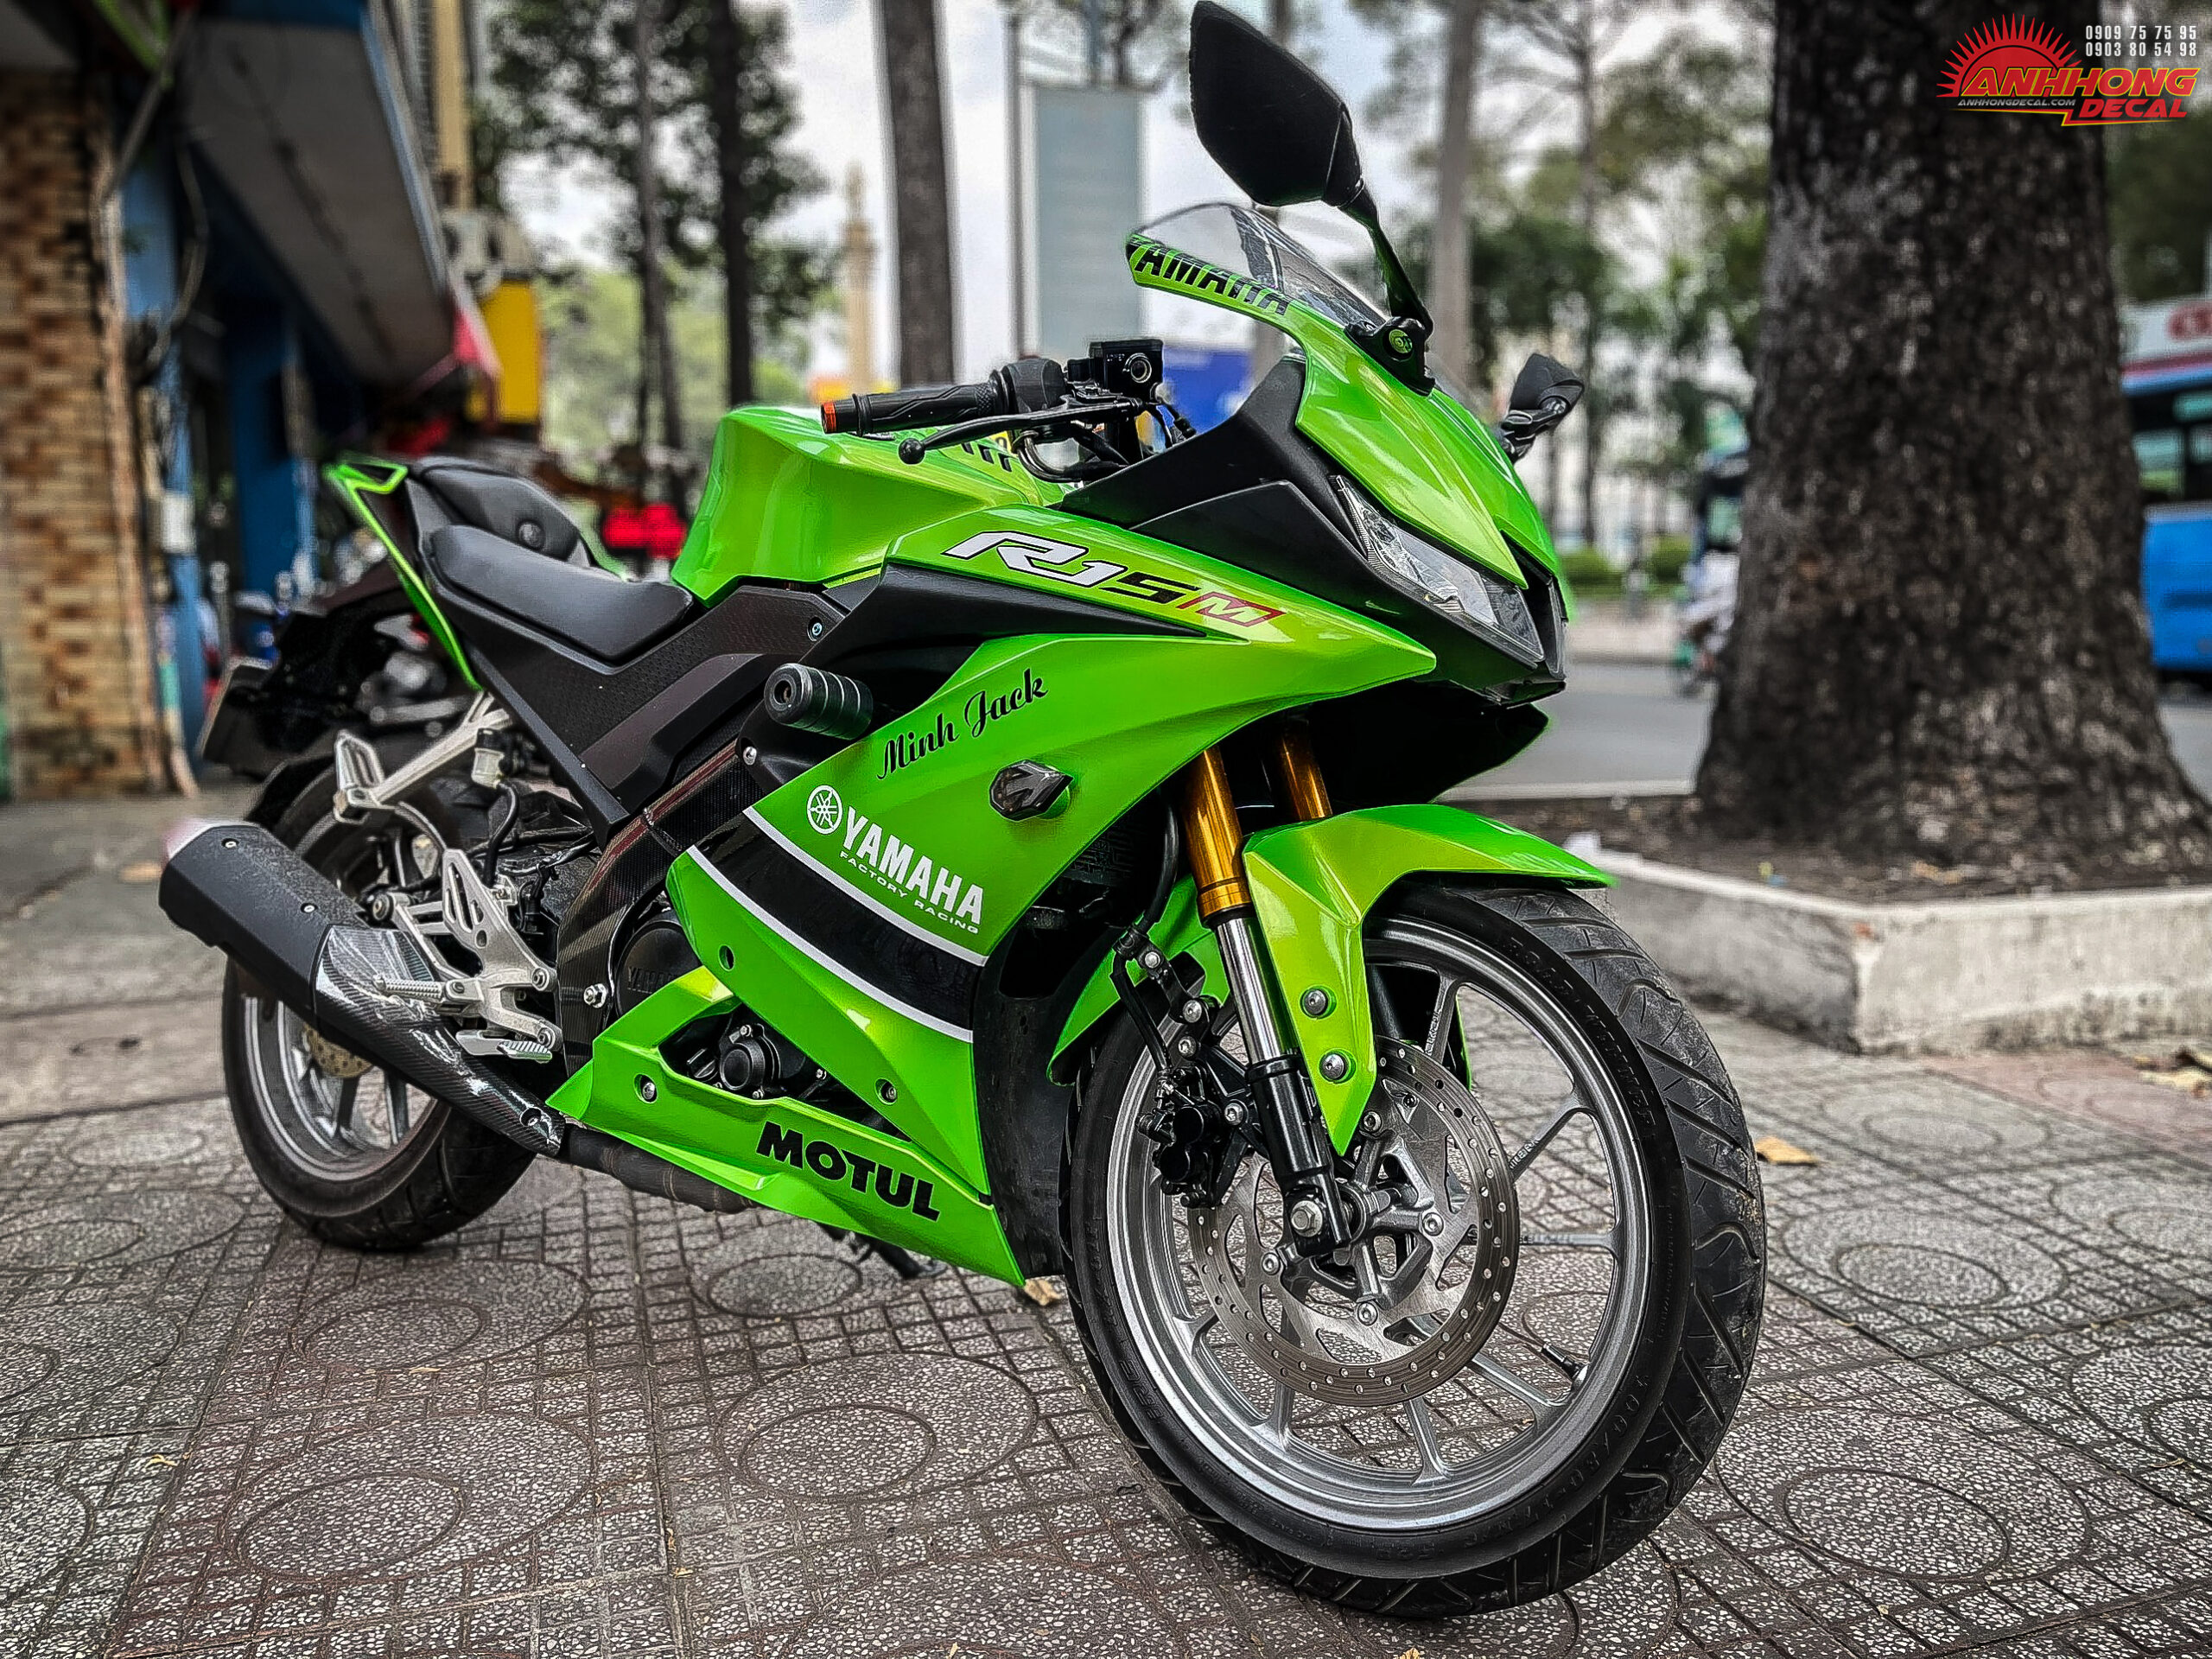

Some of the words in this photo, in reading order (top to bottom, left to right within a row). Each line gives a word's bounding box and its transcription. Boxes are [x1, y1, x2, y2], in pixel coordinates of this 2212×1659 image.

[877, 713, 960, 780] Minh
[963, 668, 1048, 737] Jack
[839, 850, 908, 899] FACTORY
[913, 899, 979, 934] RACING
[843, 805, 983, 925] YAMAHA
[756, 1120, 941, 1223] MOTUL
